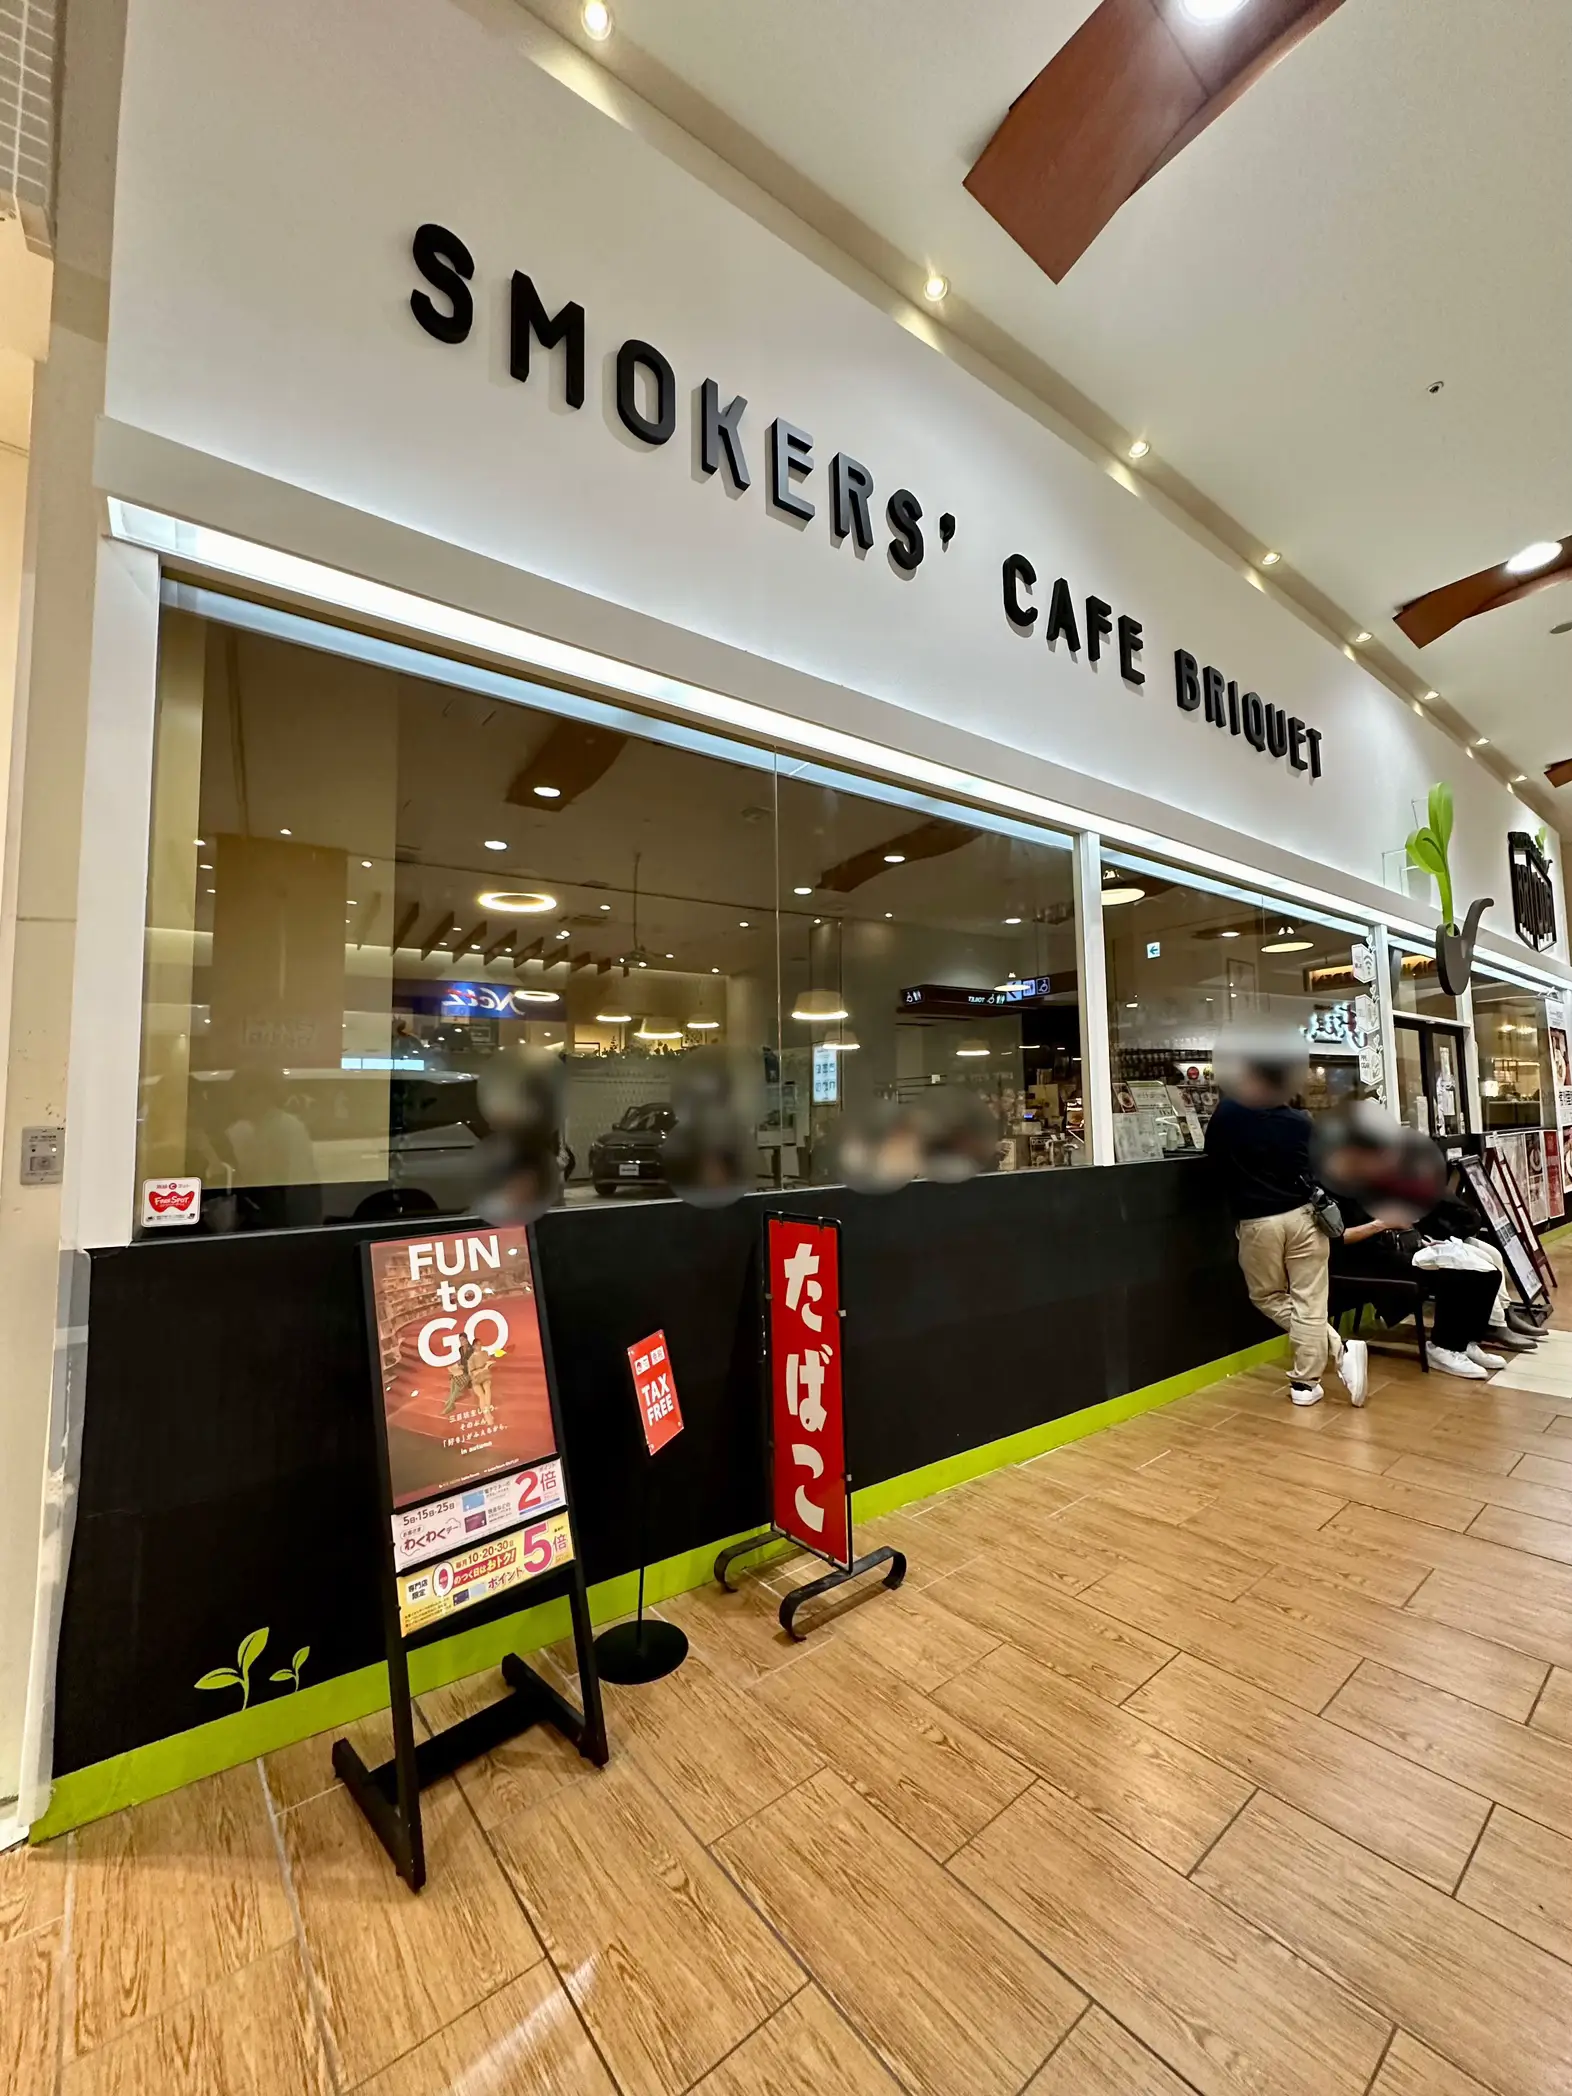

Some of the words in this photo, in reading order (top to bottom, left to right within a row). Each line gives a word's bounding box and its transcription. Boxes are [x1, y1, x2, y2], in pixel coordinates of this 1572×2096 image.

[410, 223, 956, 570] SMOKERS'
[1002, 553, 1146, 685] CAFE
[1174, 648, 1322, 779] BRIQUET
[408, 1234, 501, 1281] FUN
[436, 1280, 482, 1312] to
[417, 1309, 509, 1367] GO
[641, 1373, 670, 1407] TAX
[647, 1393, 675, 1427] FREE
[783, 1242, 834, 1533] たばこ
